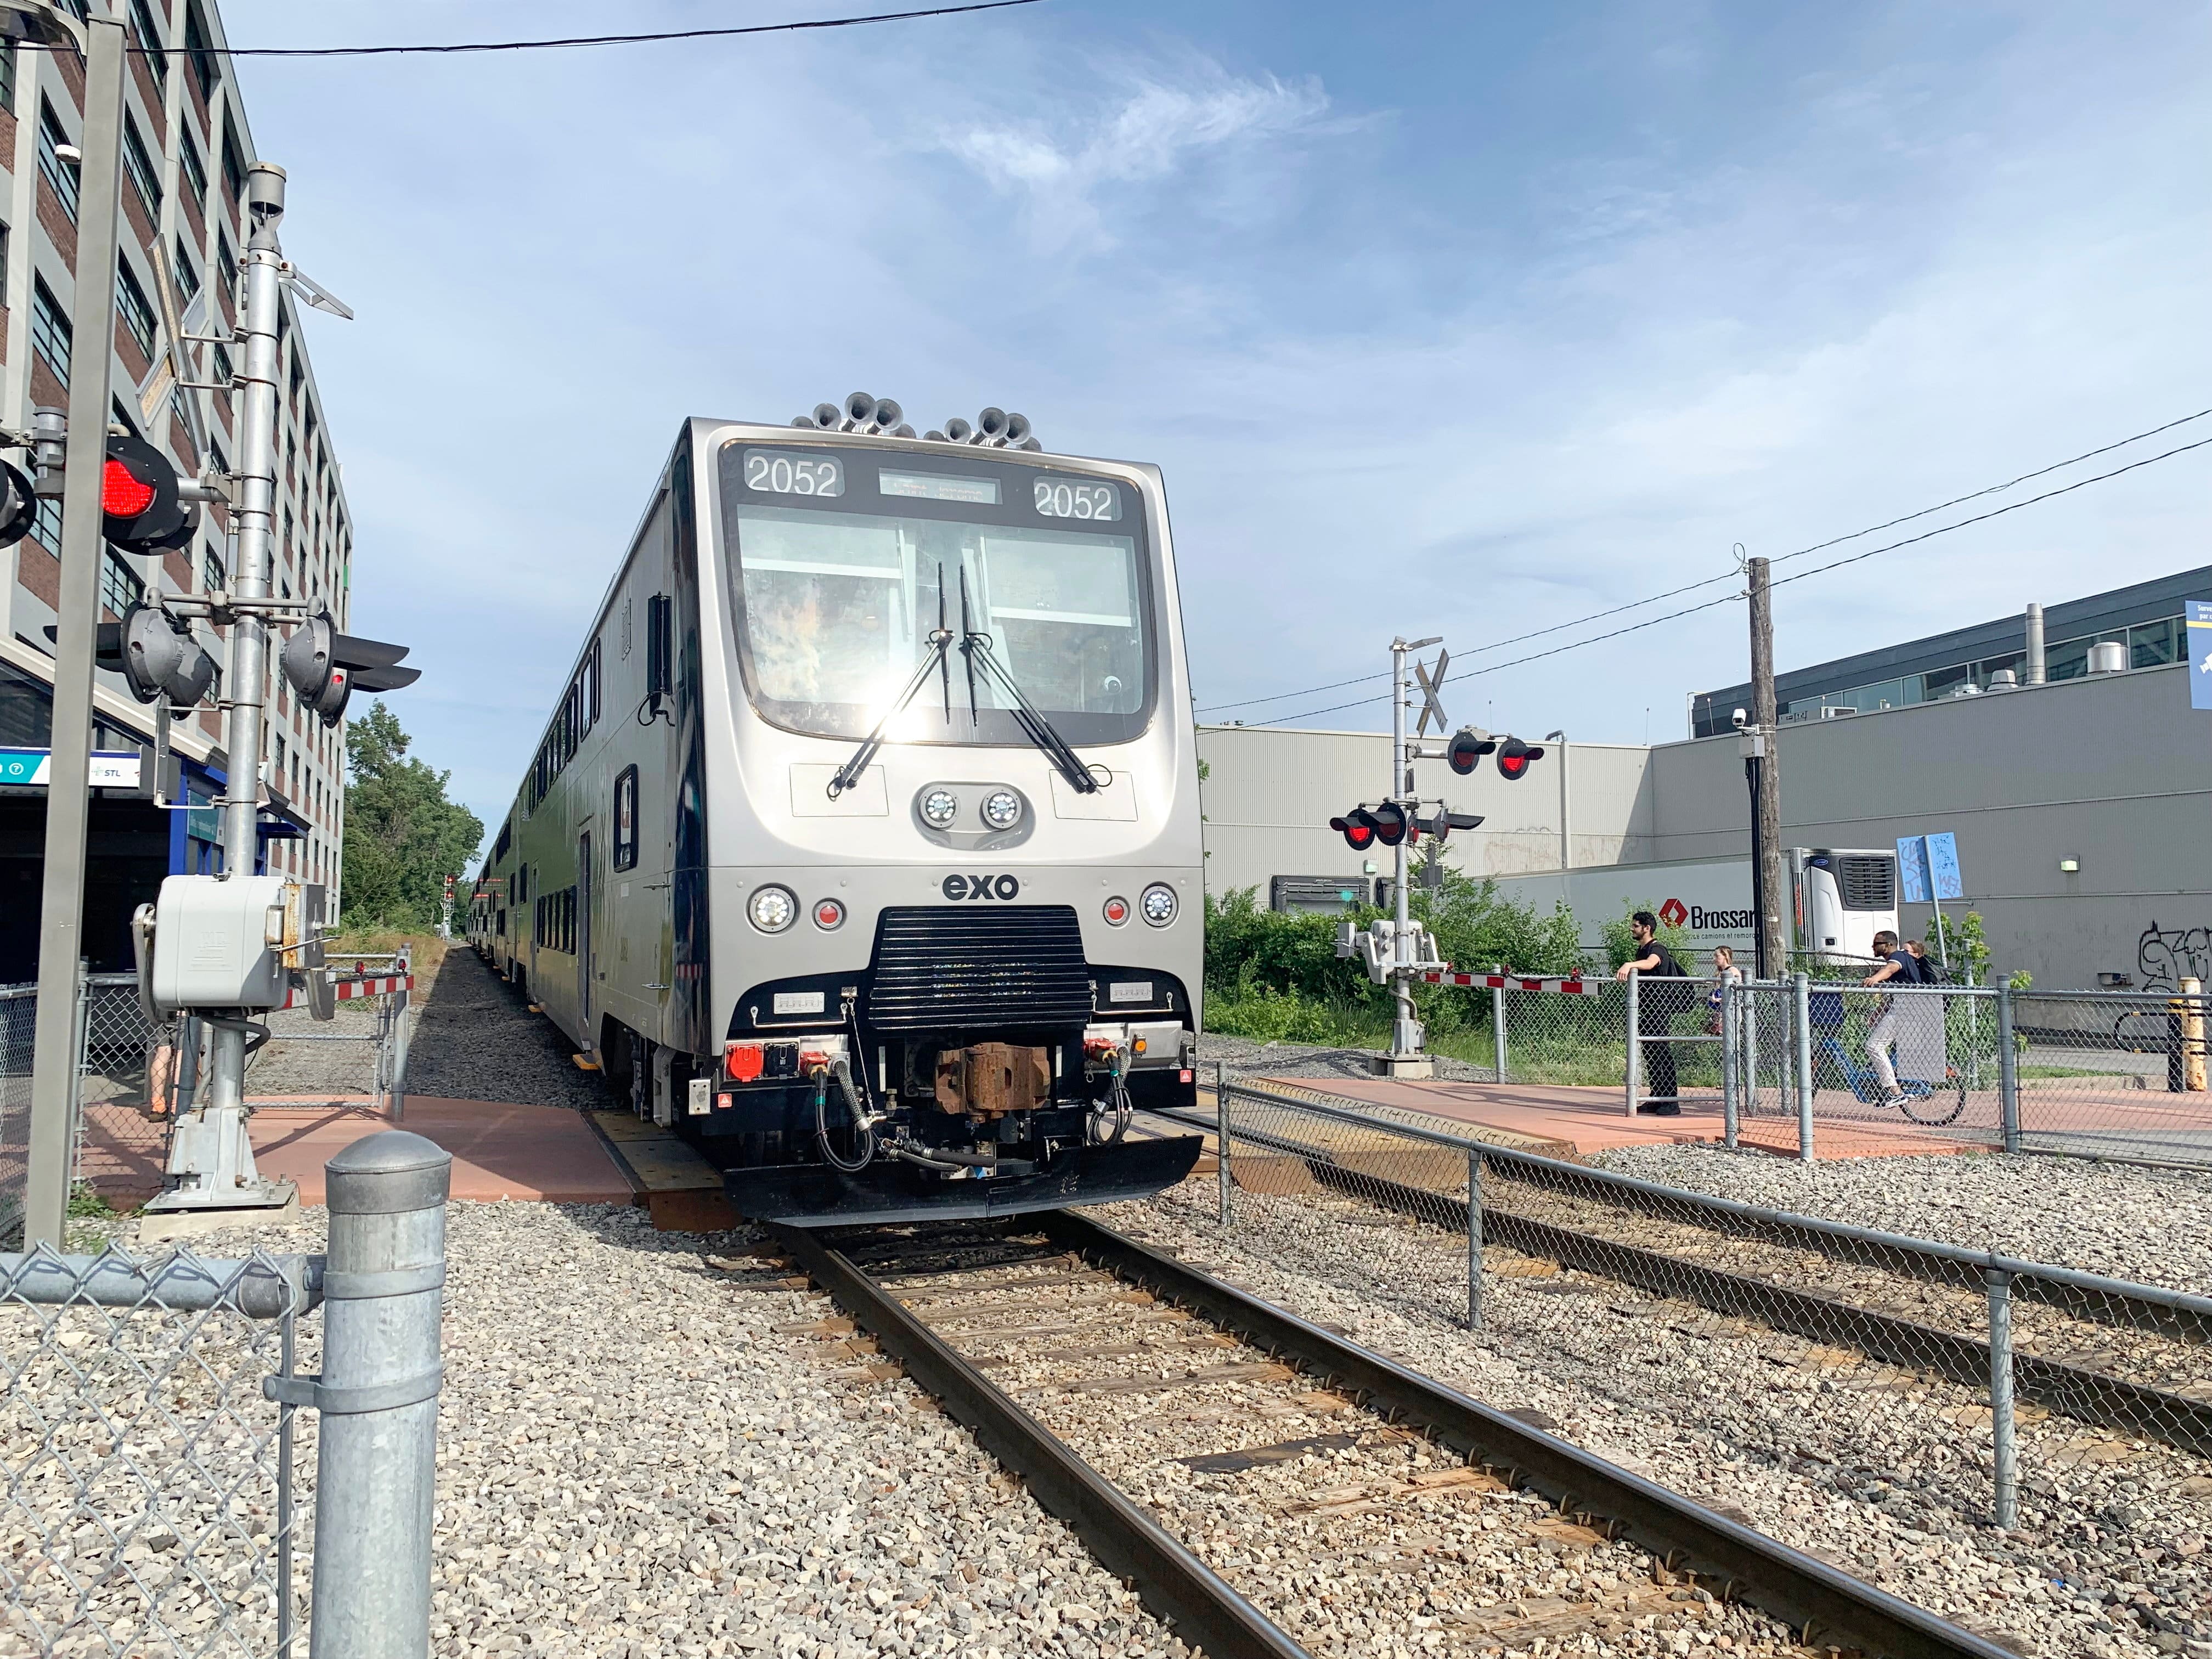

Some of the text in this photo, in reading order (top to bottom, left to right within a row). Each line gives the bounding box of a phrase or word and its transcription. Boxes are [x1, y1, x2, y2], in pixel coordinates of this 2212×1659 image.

[748, 456, 837, 497] 2052
[1034, 483, 1112, 521] 2052
[942, 874, 1019, 901] exo
